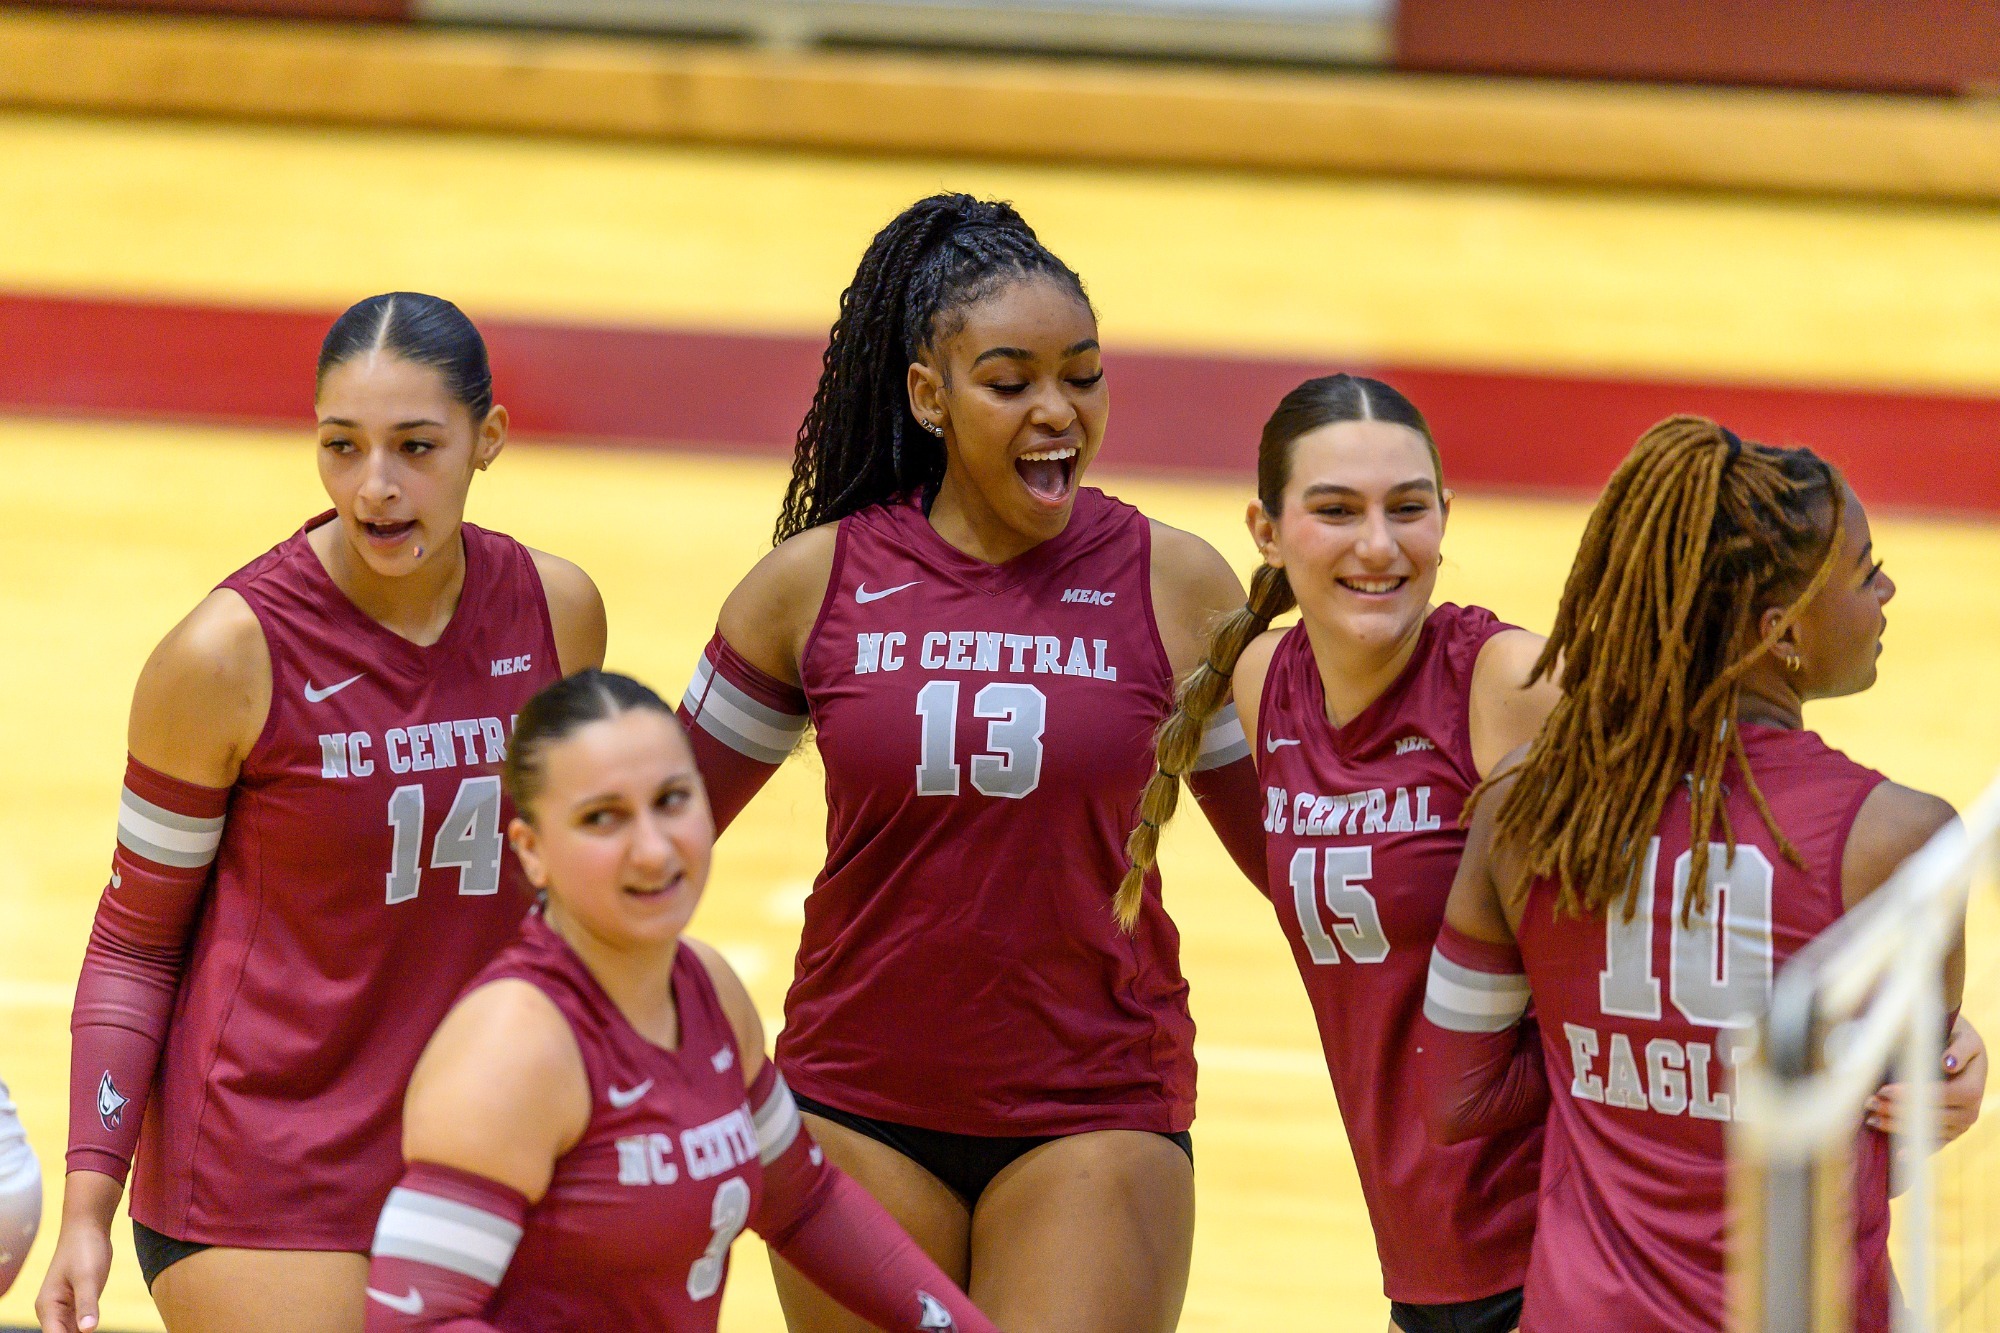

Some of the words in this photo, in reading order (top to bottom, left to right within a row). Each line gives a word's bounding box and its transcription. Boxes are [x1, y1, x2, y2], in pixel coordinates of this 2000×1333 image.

[1060, 588, 1116, 606] MEAC
[490, 654, 532, 677] MEAC
[855, 631, 907, 675] NC
[920, 631, 1117, 682] CENTRAL
[319, 731, 375, 779] NC
[384, 714, 520, 774] CENTR
[915, 680, 1047, 800] 13
[385, 775, 504, 905] 14
[1263, 786, 1288, 834] NC
[1292, 786, 1441, 836] CENTRAL
[1289, 845, 1391, 965] 15
[1600, 835, 1774, 1029] 10
[614, 1132, 679, 1187] NC
